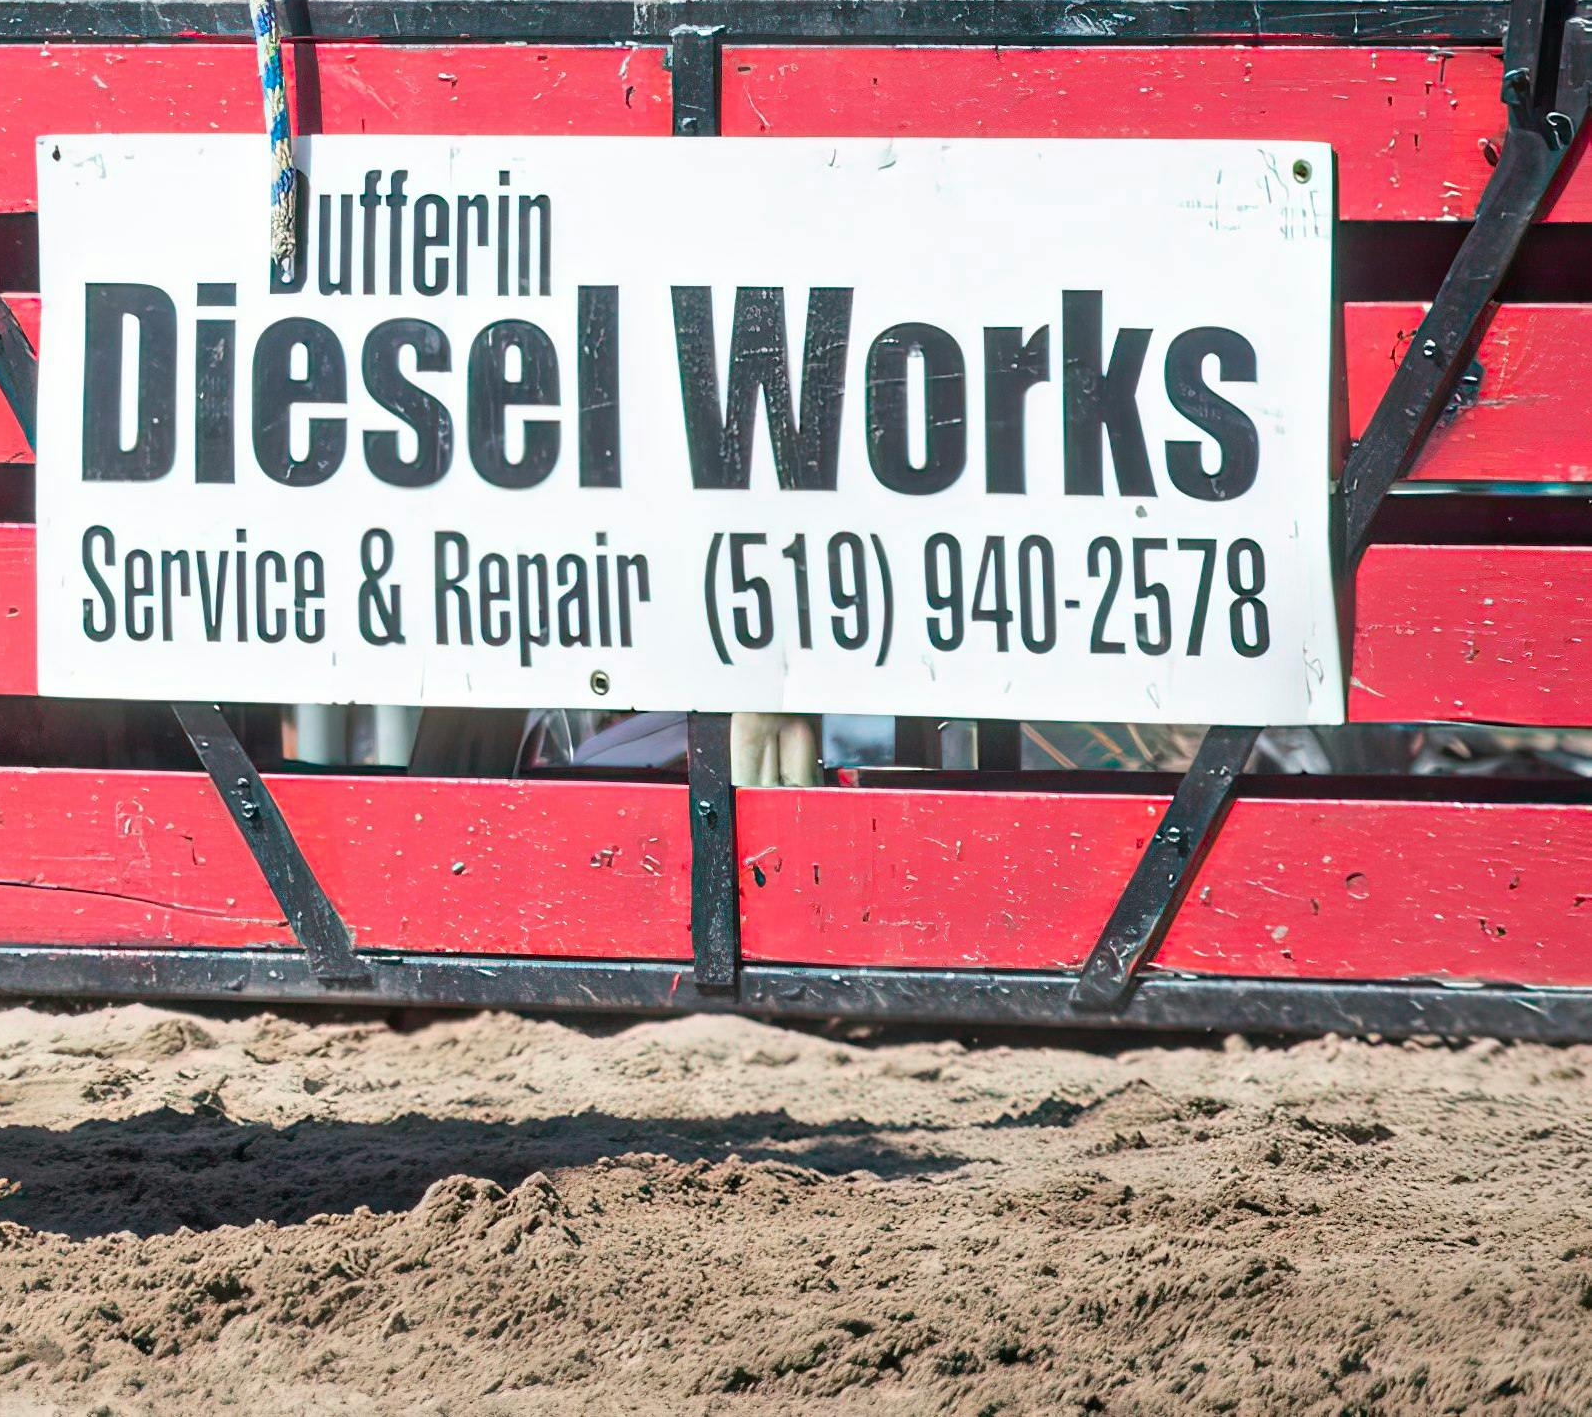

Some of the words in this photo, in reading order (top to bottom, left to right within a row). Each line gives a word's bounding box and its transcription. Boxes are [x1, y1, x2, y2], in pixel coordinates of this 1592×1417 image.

[81, 281, 623, 490] Diesel
[669, 284, 1261, 503] Works
[81, 523, 326, 645] Service
[357, 526, 407, 647] &
[433, 528, 652, 668] Repair
[703, 530, 895, 668] (519)
[923, 531, 1272, 659] 940-2578
